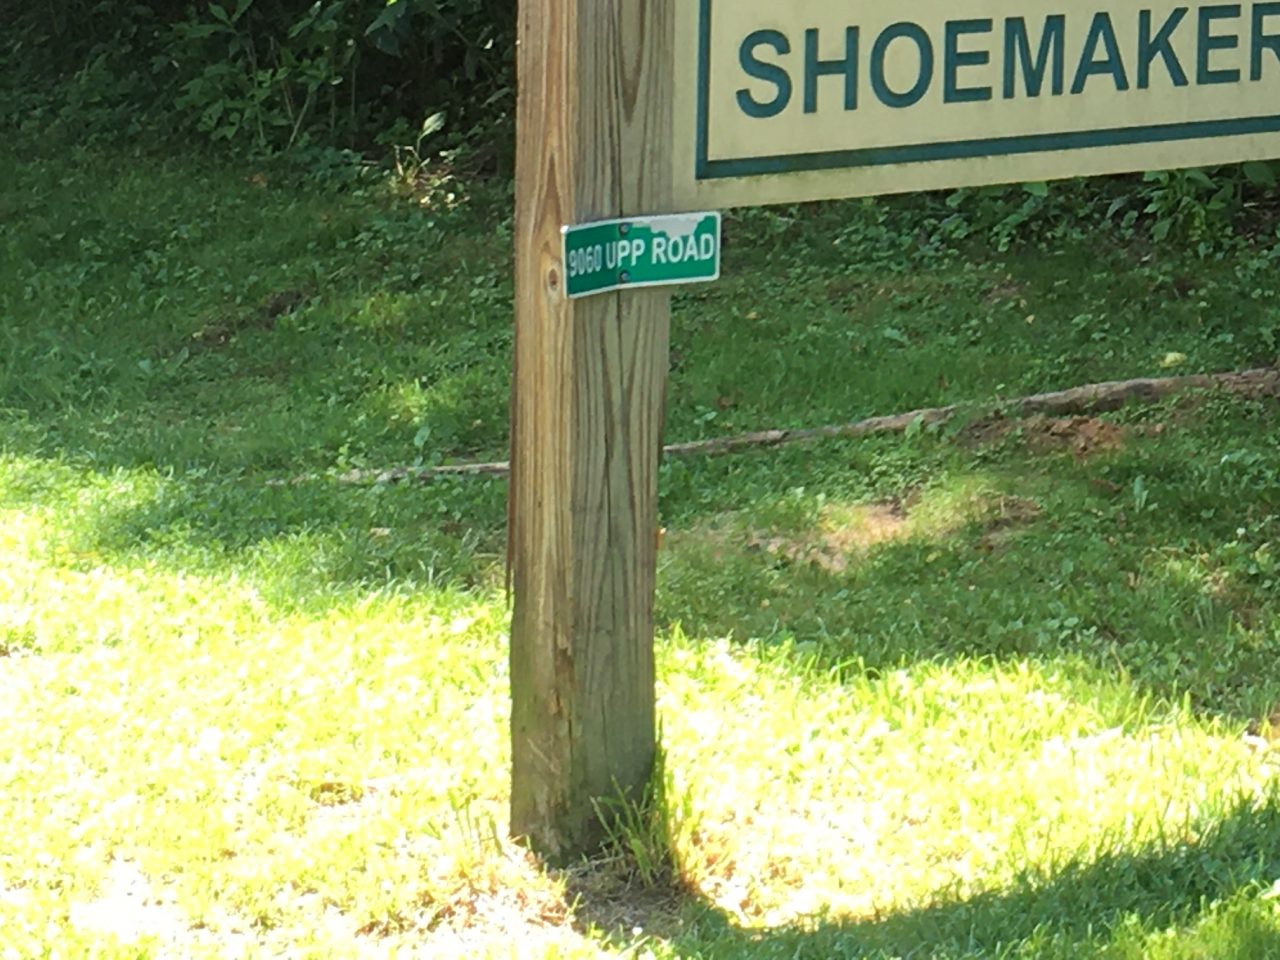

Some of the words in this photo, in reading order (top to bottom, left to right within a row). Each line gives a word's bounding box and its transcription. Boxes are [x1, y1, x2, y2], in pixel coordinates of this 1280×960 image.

[568, 243, 603, 278] 9060
[605, 238, 646, 270] UPP
[651, 232, 715, 265] ROAD
